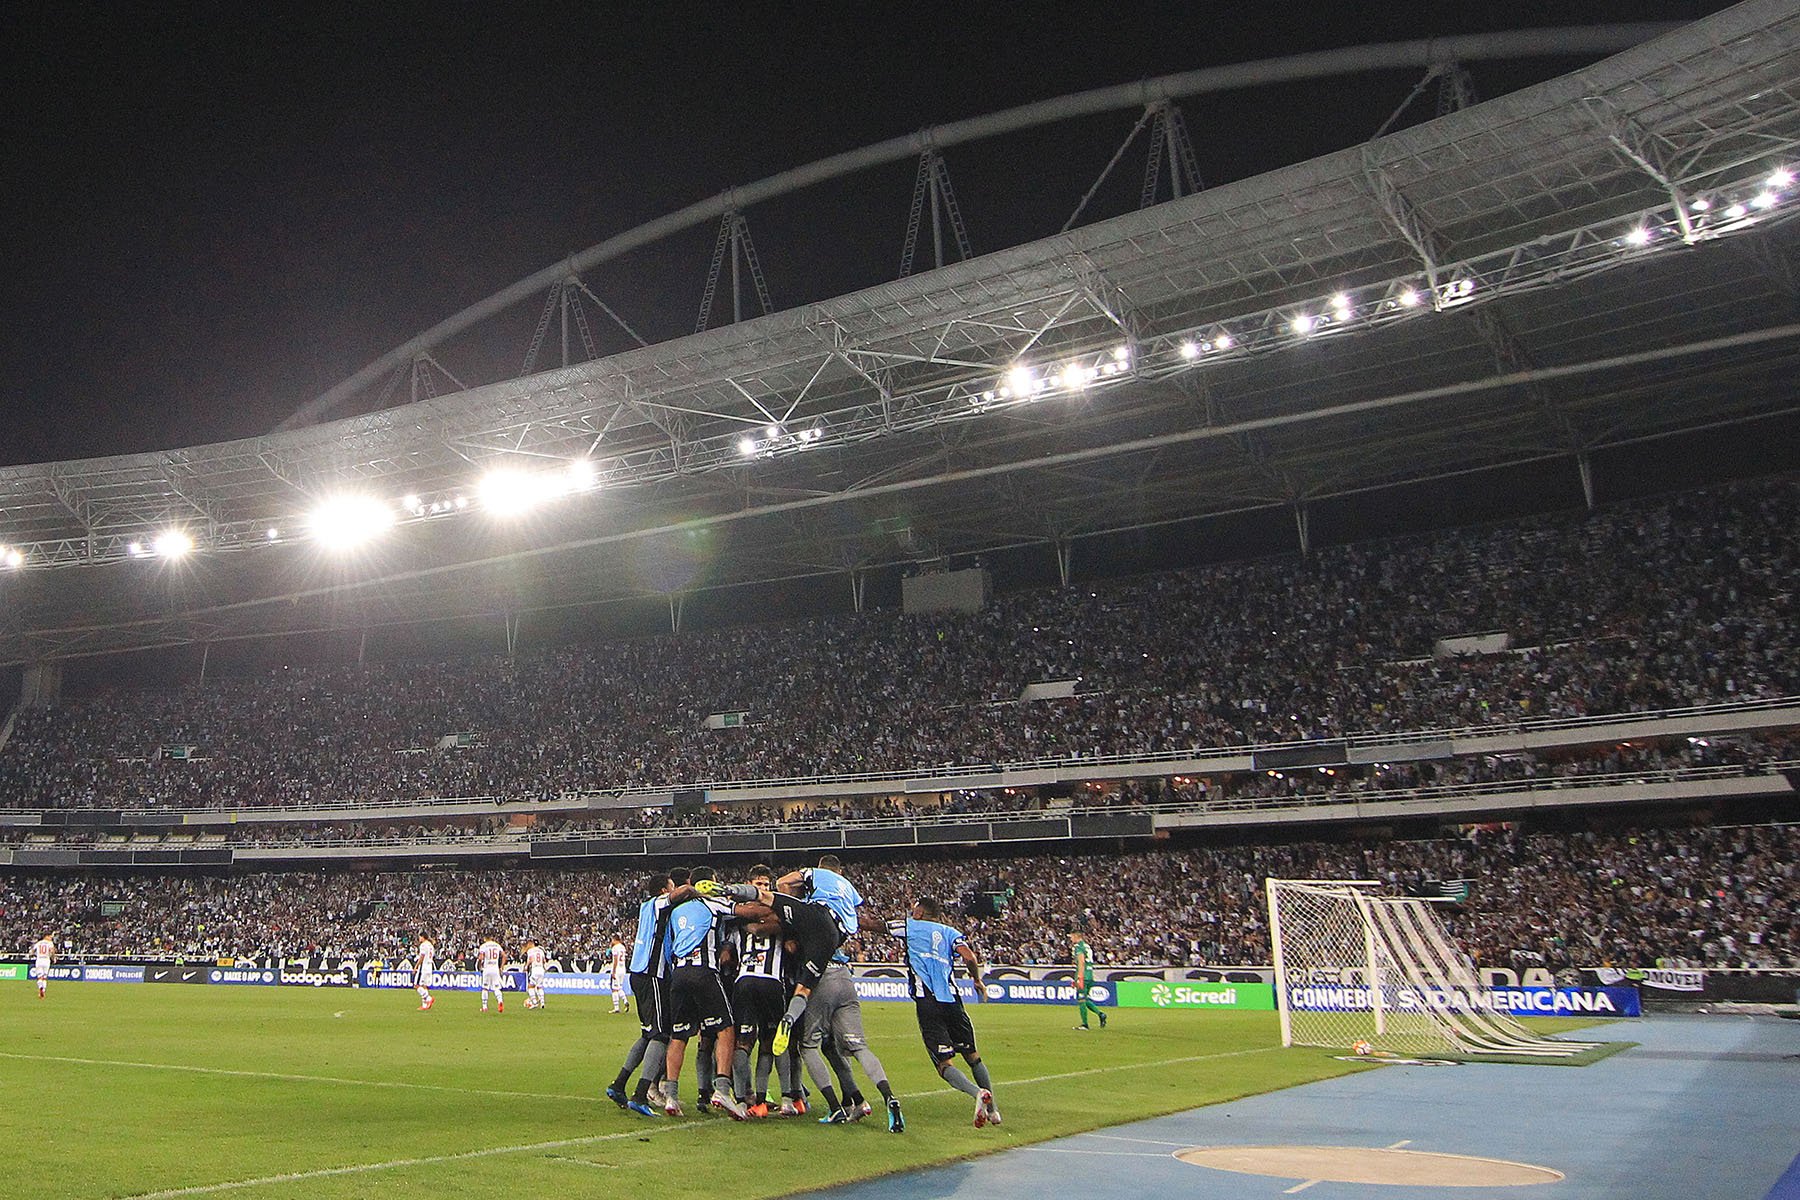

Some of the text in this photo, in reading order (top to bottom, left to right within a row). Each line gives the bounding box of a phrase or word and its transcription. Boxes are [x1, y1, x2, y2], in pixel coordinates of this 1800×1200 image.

[39, 944, 47, 955] 10
[489, 948, 498, 960] 16
[535, 952, 541, 962] 8
[85, 969, 113, 980] CONMEBOL
[223, 971, 261, 981] BAIXE O APP
[281, 969, 348, 986] bodog.net
[1009, 985, 1045, 999] BAIXE
[1046, 986, 1054, 999] O
[1174, 987, 1236, 1005] Sicredi
